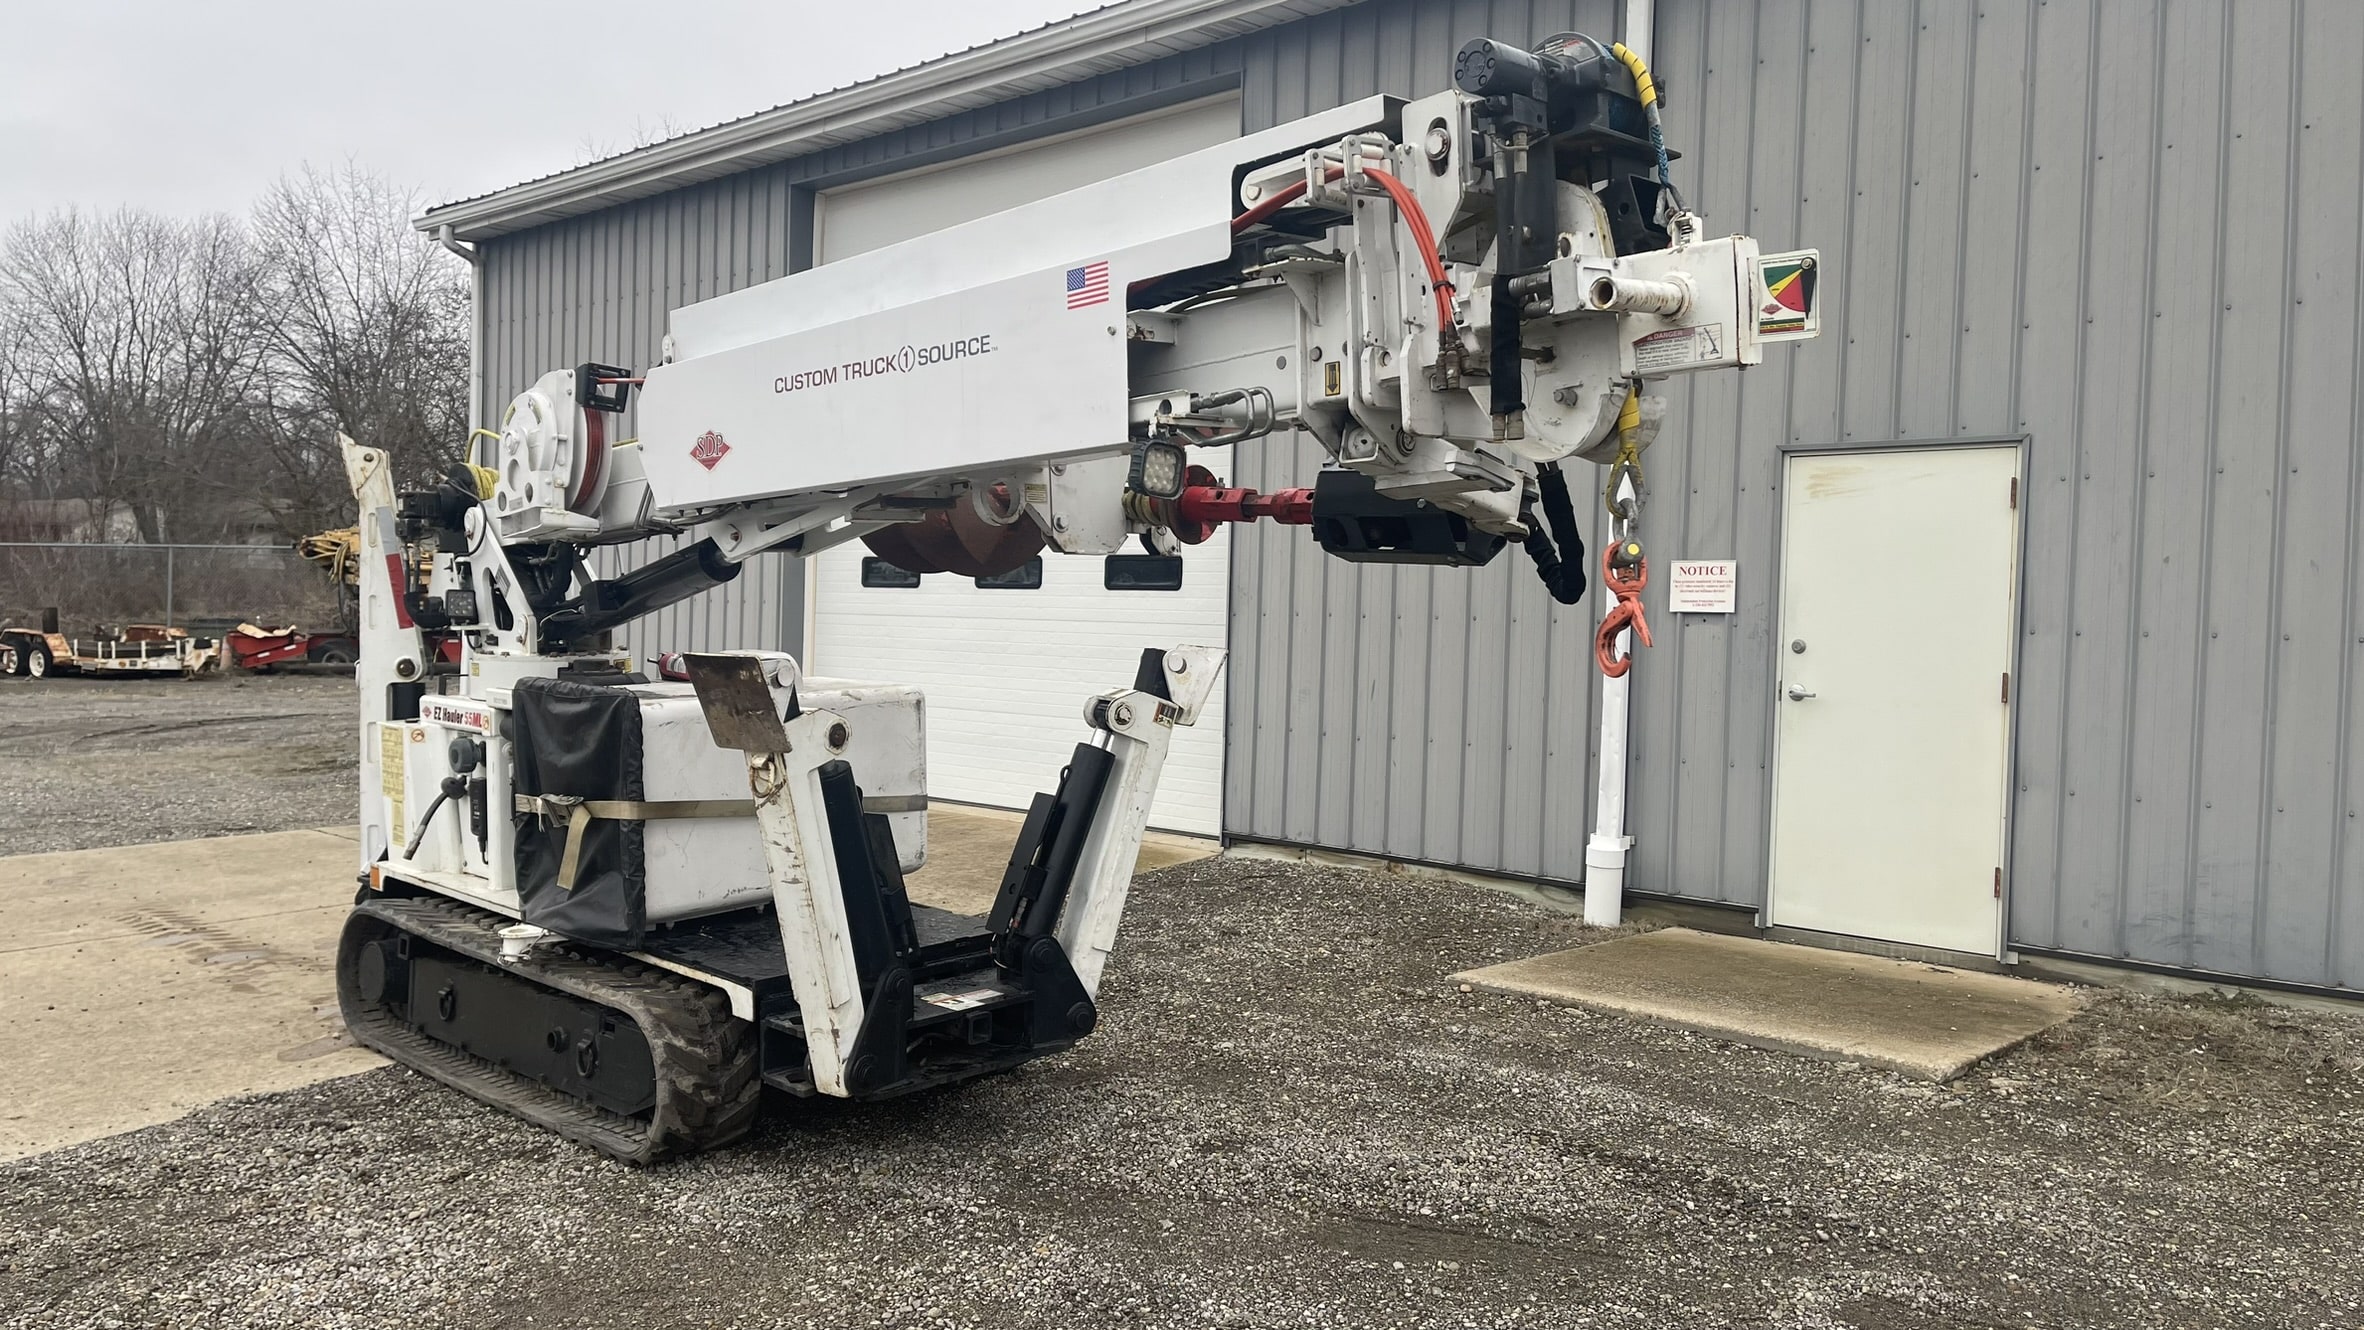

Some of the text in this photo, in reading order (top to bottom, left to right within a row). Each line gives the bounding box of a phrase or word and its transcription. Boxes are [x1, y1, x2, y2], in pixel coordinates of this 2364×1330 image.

[1653, 330, 1683, 339] DANGER
[774, 367, 837, 394] CUSTOM
[842, 354, 897, 381] TRUCK
[917, 335, 991, 366] SOURCE
[696, 433, 724, 459] SDP
[1679, 565, 1727, 576] NOTICE
[433, 706, 442, 721] EZ
[442, 707, 464, 725] Hauler
[464, 711, 483, 728] 55ML
